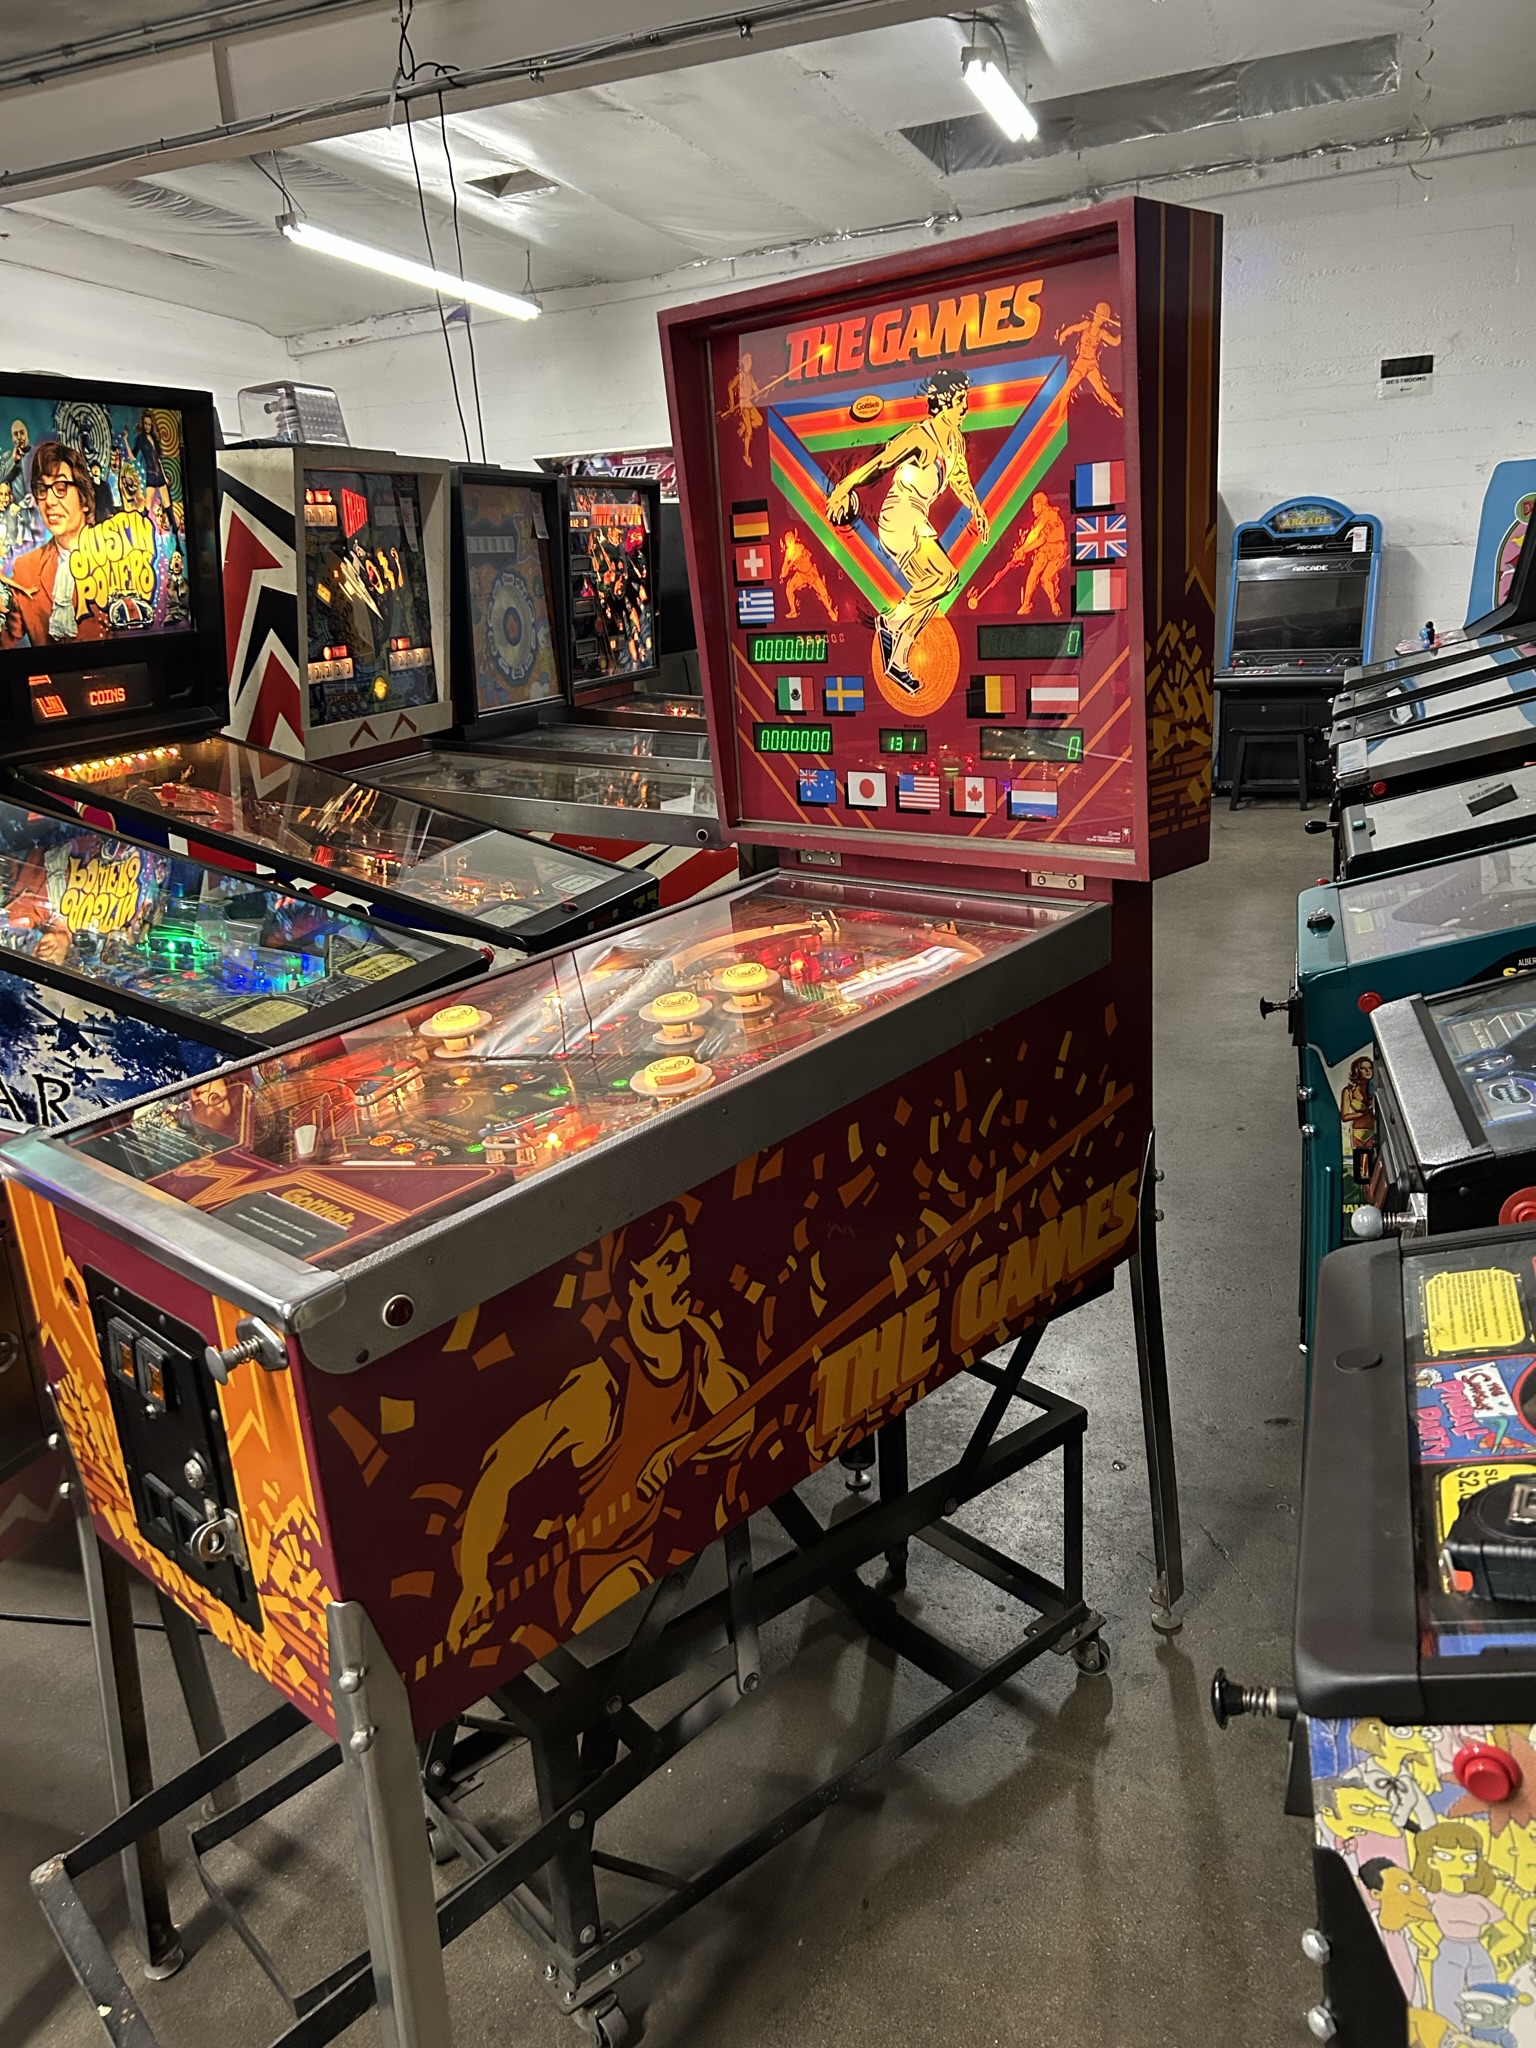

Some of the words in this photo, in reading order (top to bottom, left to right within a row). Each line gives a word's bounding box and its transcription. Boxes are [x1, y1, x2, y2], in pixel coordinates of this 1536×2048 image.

[785, 316, 867, 383] THE
[868, 279, 1044, 367] GAMES
[1385, 376, 1427, 385] RESTROOMS
[856, 402, 880, 411] Gottlieb
[612, 463, 659, 478] TIME
[655, 463, 677, 490] 4
[1282, 515, 1332, 528] ARCADE
[69, 510, 155, 579] AUSTIN
[74, 549, 156, 620] POWERS
[1292, 564, 1329, 572] ARCADE
[88, 688, 126, 706] COINS
[889, 736, 903, 751] 13
[281, 1188, 356, 1227] Gottlieb
[812, 1288, 941, 1446] THE
[953, 1167, 1139, 1350] GAMES
[1432, 1379, 1490, 1440] PINBALL
[1411, 1406, 1452, 1457] PARTY
